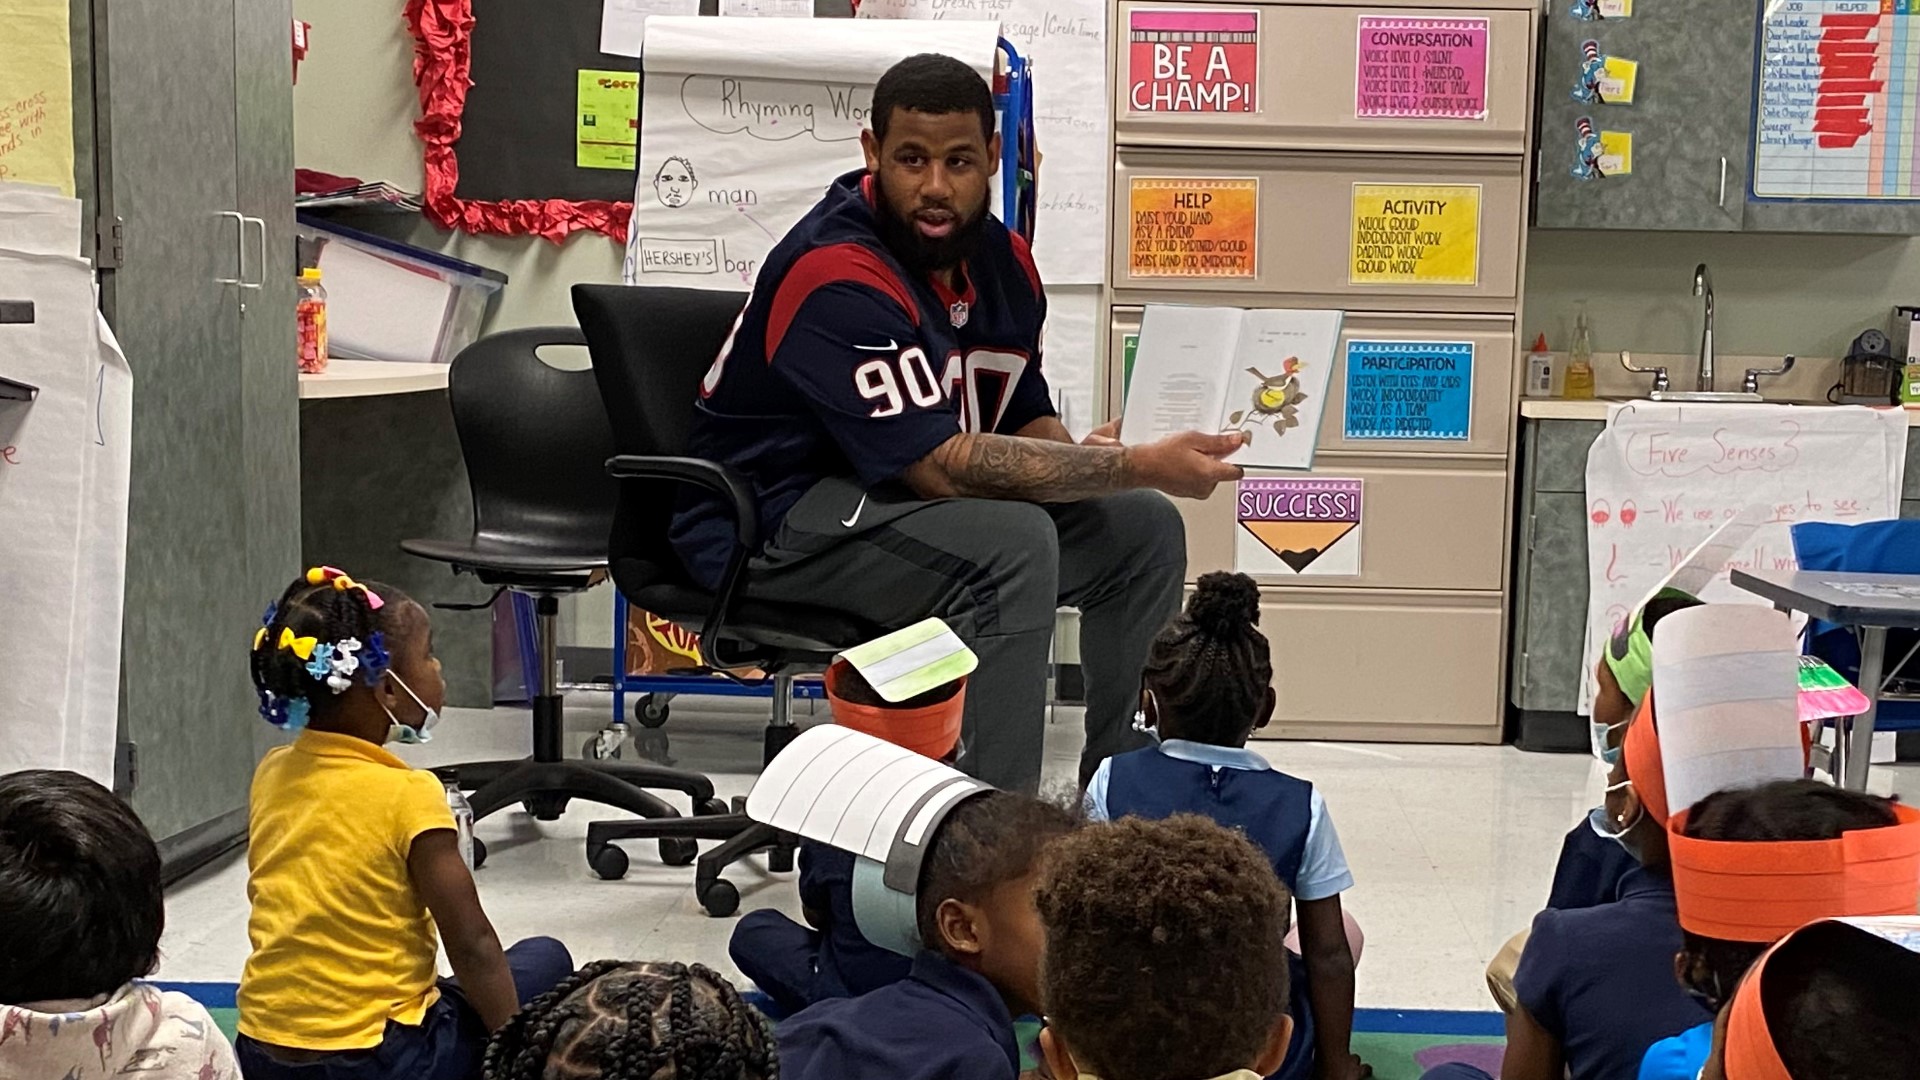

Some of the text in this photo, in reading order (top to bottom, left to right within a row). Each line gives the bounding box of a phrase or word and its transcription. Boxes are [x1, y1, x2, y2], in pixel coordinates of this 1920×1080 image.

[1786, 2, 1868, 12] JOB HELPER
[1785, 14, 1809, 27] Leader
[1153, 43, 1232, 82] BE A
[1363, 50, 1388, 63] VOICE
[1363, 65, 1388, 79] VOICE
[1363, 80, 1388, 93] VOICE
[1130, 81, 1251, 113] CHAMP!
[721, 78, 872, 132] Rhyming Wor
[19, 106, 46, 128] with
[31, 126, 42, 139] in
[1761, 119, 1792, 135] Sweeper
[708, 188, 757, 205] man
[1174, 193, 1212, 209] HELP
[1163, 211, 1188, 225] YOUR
[1190, 211, 1213, 225] HAND
[1358, 217, 1420, 231] WHOLE GROUP
[1135, 225, 1195, 239] ASK A FRIEND
[1414, 231, 1441, 246] WORK
[1135, 240, 1153, 252] ASK
[1155, 240, 1178, 252] YOUR
[1356, 245, 1424, 260] PARTNER WORK
[643, 238, 755, 273] HERSHEY'S bar
[1356, 259, 1417, 274] GROUP WORK
[854, 347, 942, 418] 90
[1350, 388, 1378, 401] WORK
[1350, 402, 1378, 416] WORK
[1380, 402, 1393, 416] AS
[1405, 402, 1427, 417] TEAM
[1349, 416, 1377, 431] WORK
[1649, 427, 1777, 464] Five Senses
[1239, 491, 1356, 519] SUCCESS!
[1662, 492, 1684, 524] We
[1693, 509, 1713, 521] use
[1768, 503, 1796, 521] yes
[1806, 489, 1822, 513] to
